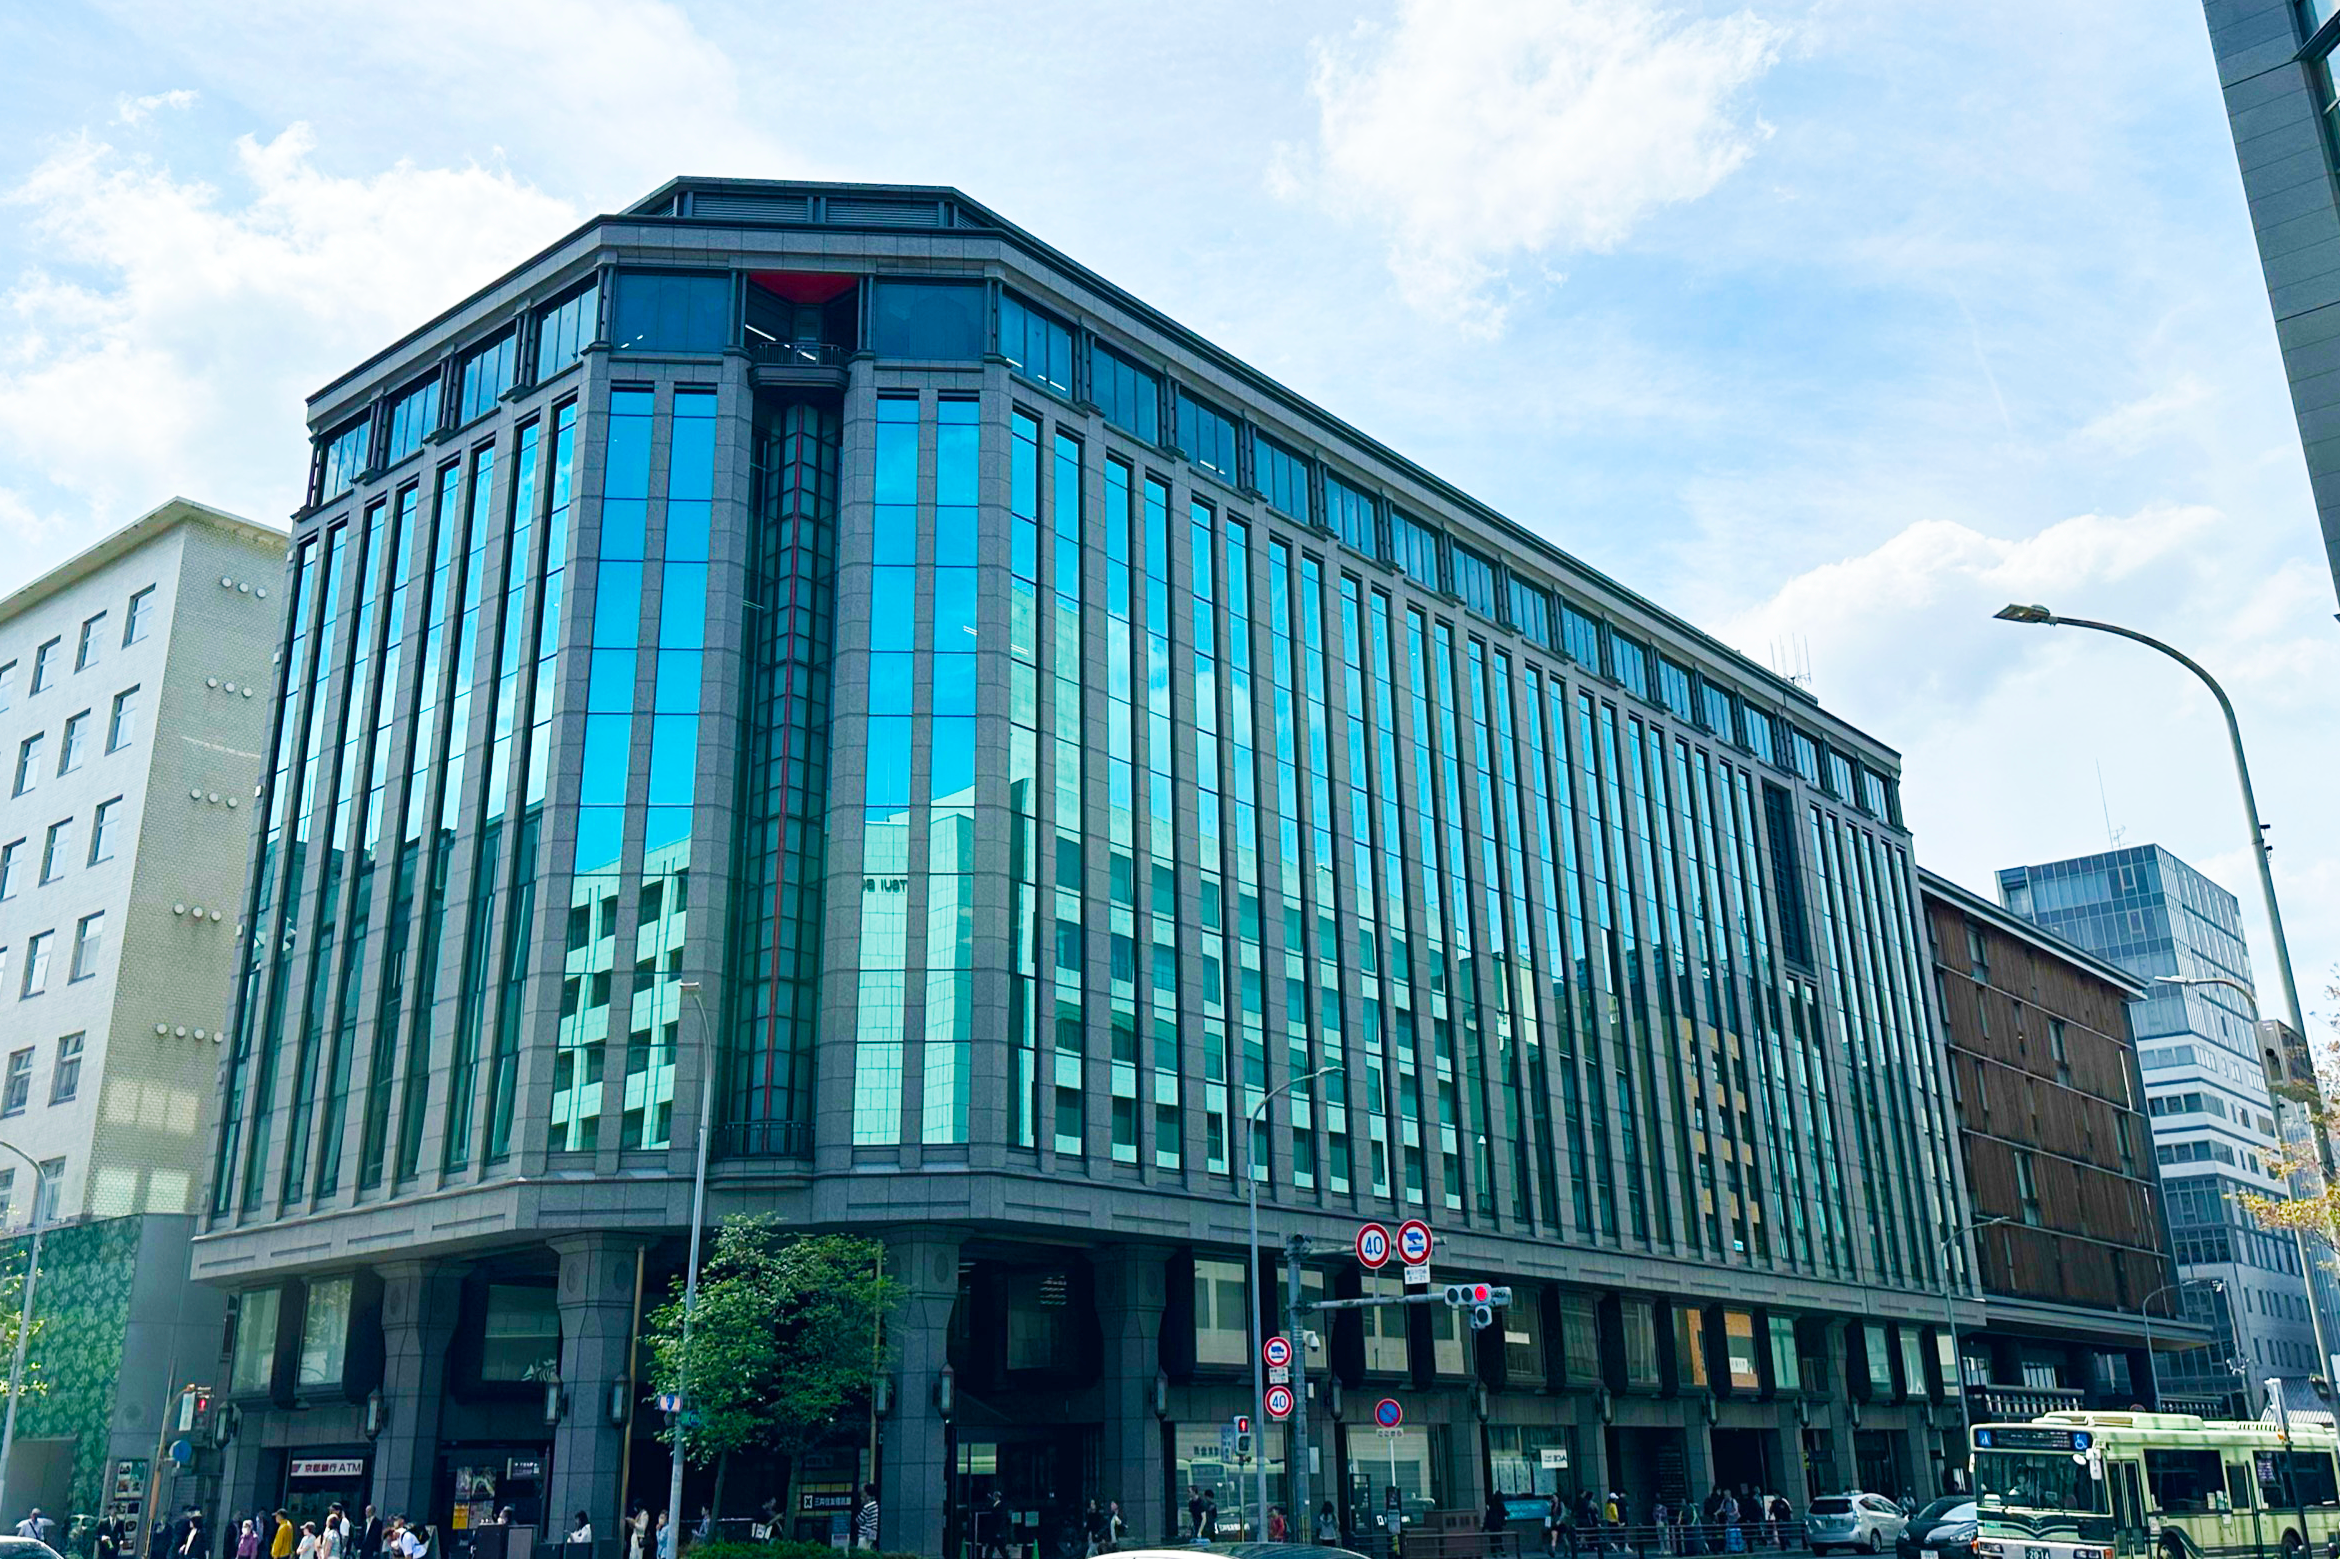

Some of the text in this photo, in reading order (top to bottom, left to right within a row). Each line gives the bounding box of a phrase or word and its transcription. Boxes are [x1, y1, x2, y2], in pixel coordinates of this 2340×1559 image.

[1365, 1236, 1383, 1255] 40
[1272, 1394, 1287, 1409] 40
[1377, 1430, 1403, 1438] ここから
[304, 1463, 361, 1472] 京都銀行 ATM
